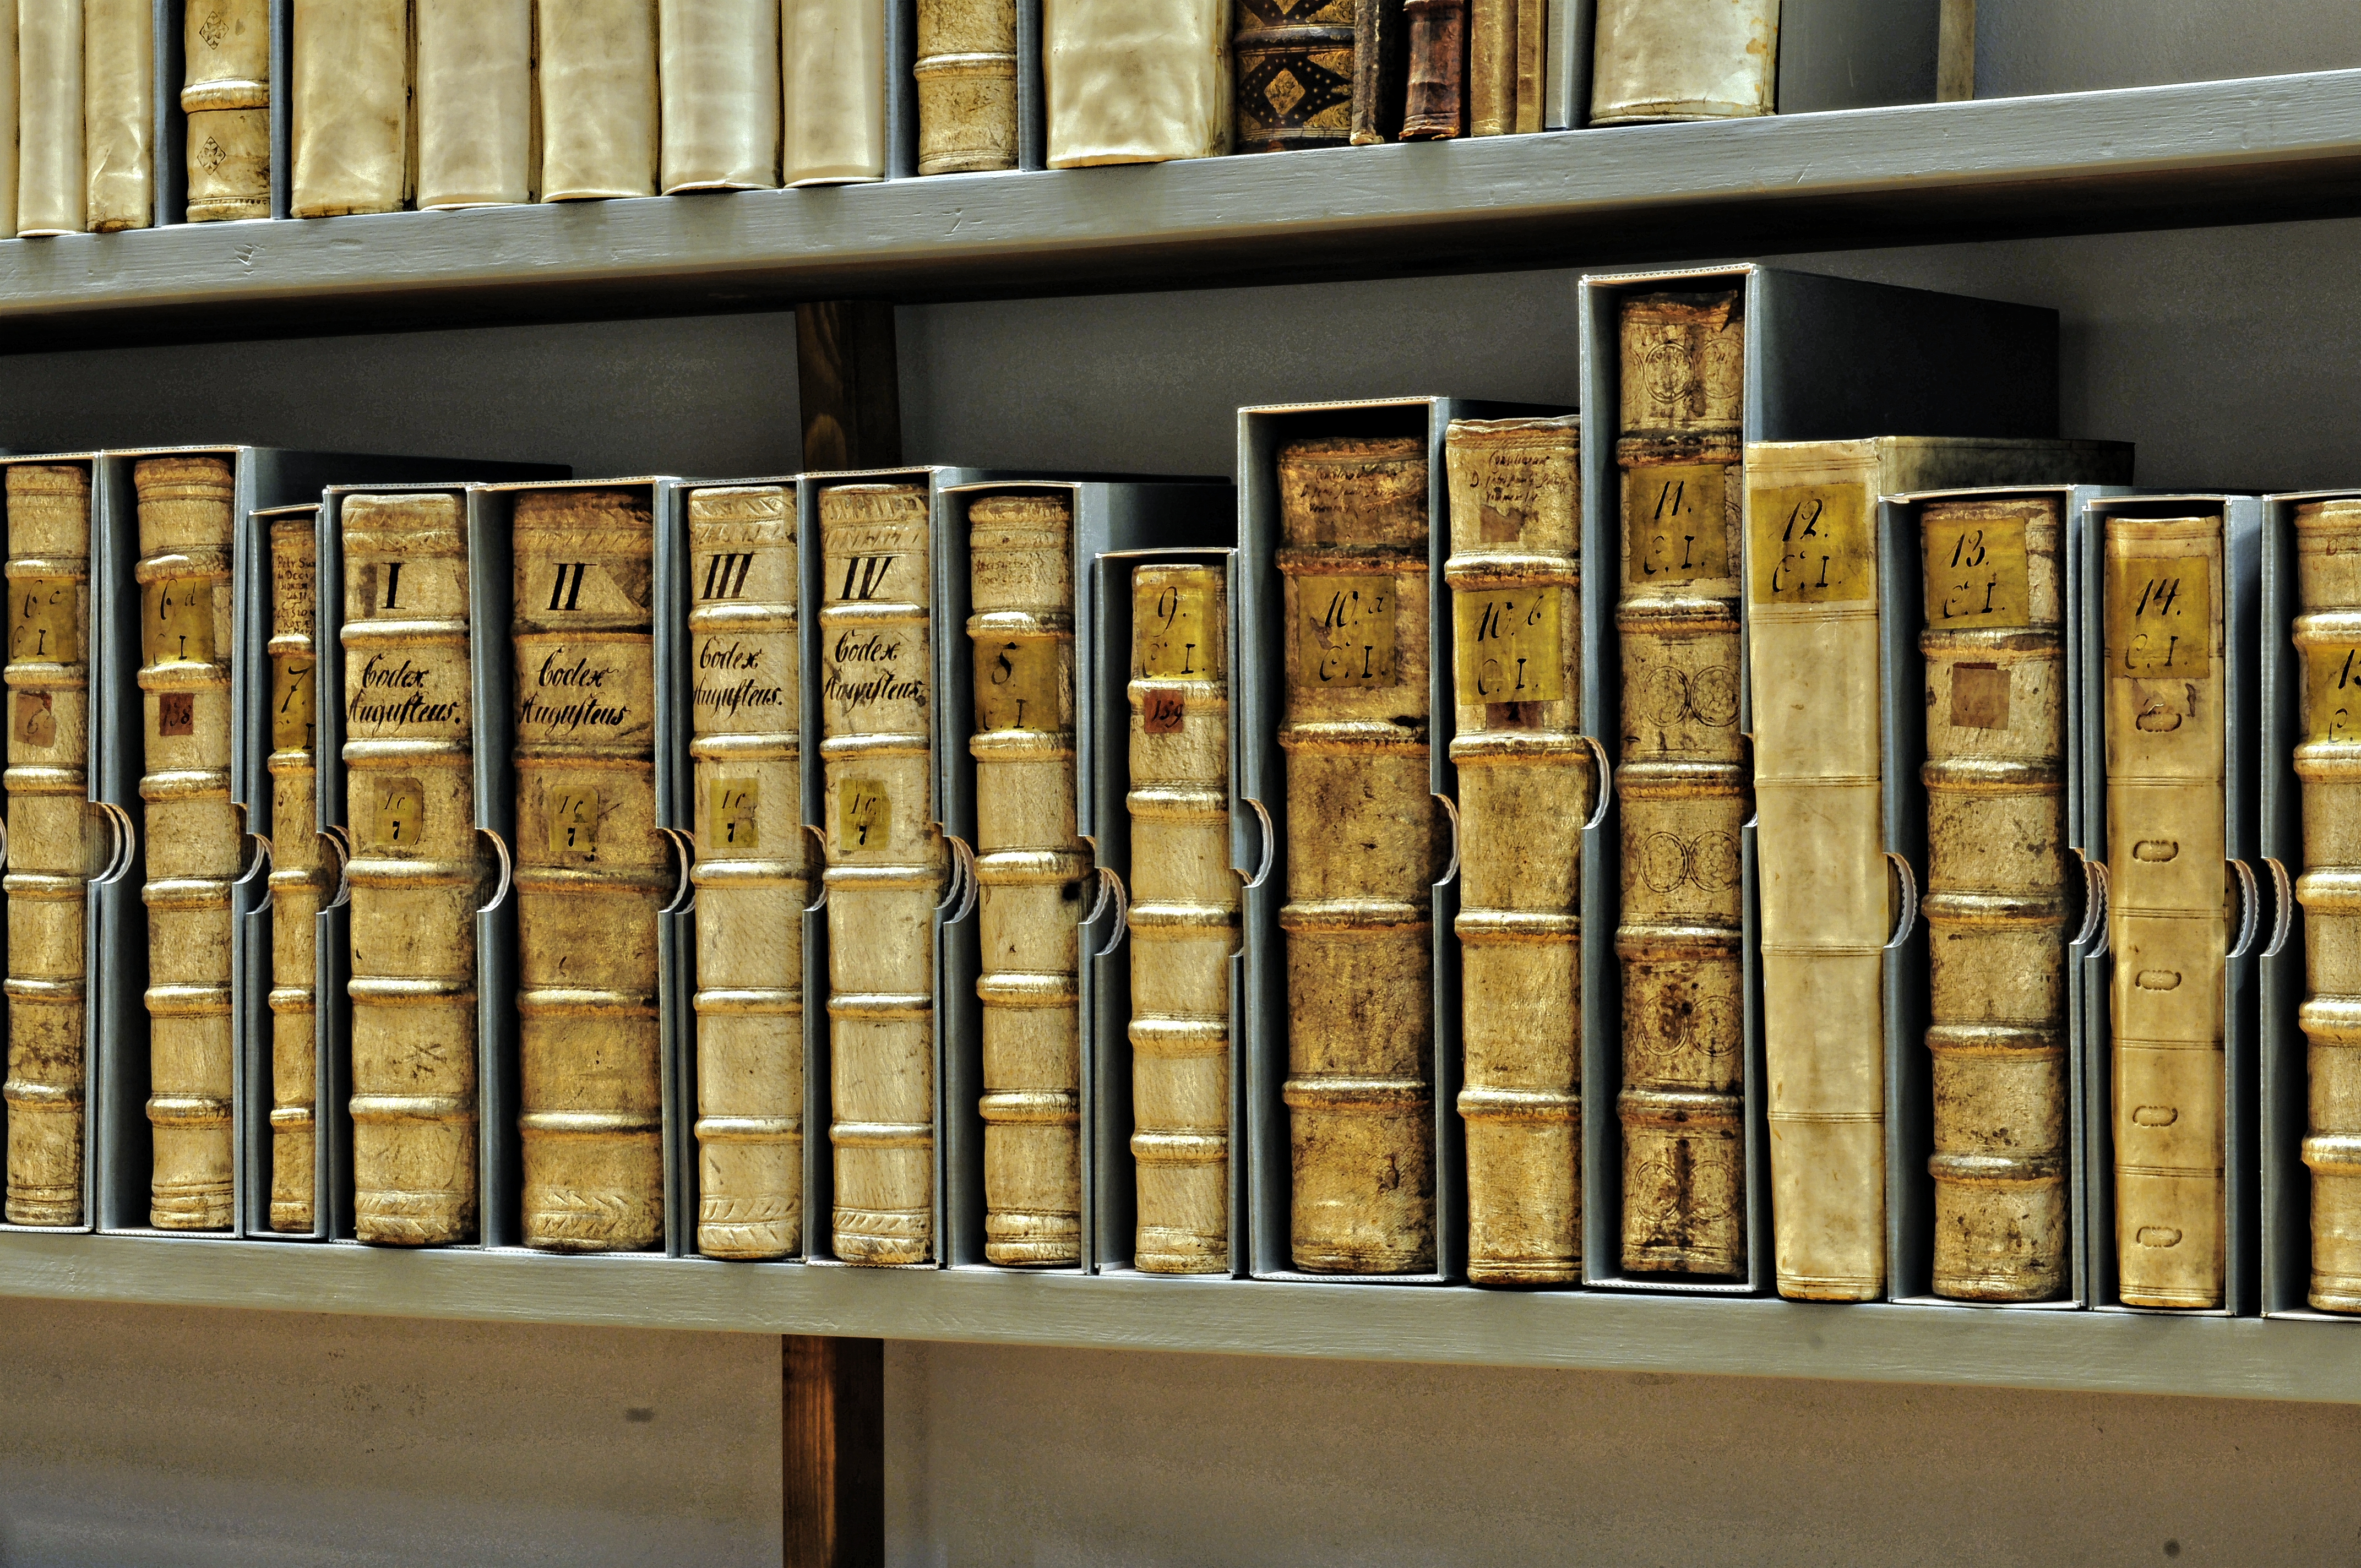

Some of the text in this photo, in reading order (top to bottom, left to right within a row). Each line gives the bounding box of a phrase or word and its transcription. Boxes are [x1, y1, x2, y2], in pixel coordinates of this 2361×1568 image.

[380, 562, 409, 609] I
[546, 563, 597, 611] II
[699, 552, 759, 600] III
[835, 556, 901, 601] IV
[700, 635, 765, 670] Codex
[835, 628, 902, 663] Codex
[361, 653, 430, 688] Codex
[537, 647, 619, 688] Codex
